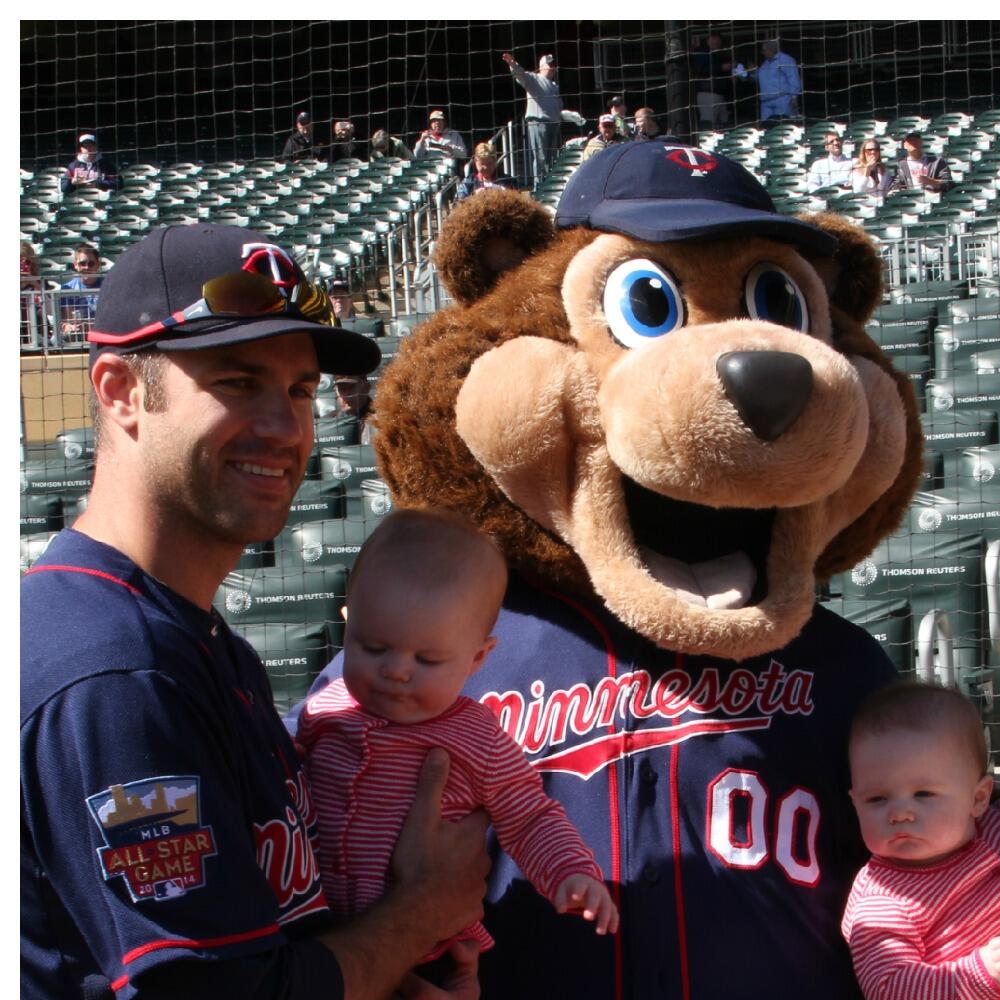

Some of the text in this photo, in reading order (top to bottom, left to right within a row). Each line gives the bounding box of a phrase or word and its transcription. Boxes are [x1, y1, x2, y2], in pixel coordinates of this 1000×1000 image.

[882, 566, 966, 577] THOMSON REUTERS
[266, 658, 307, 667] REUTERS
[140, 825, 170, 841] MLB
[705, 766, 822, 889] 00
[109, 834, 210, 870] ALL STAR
[134, 855, 196, 883] GAME
